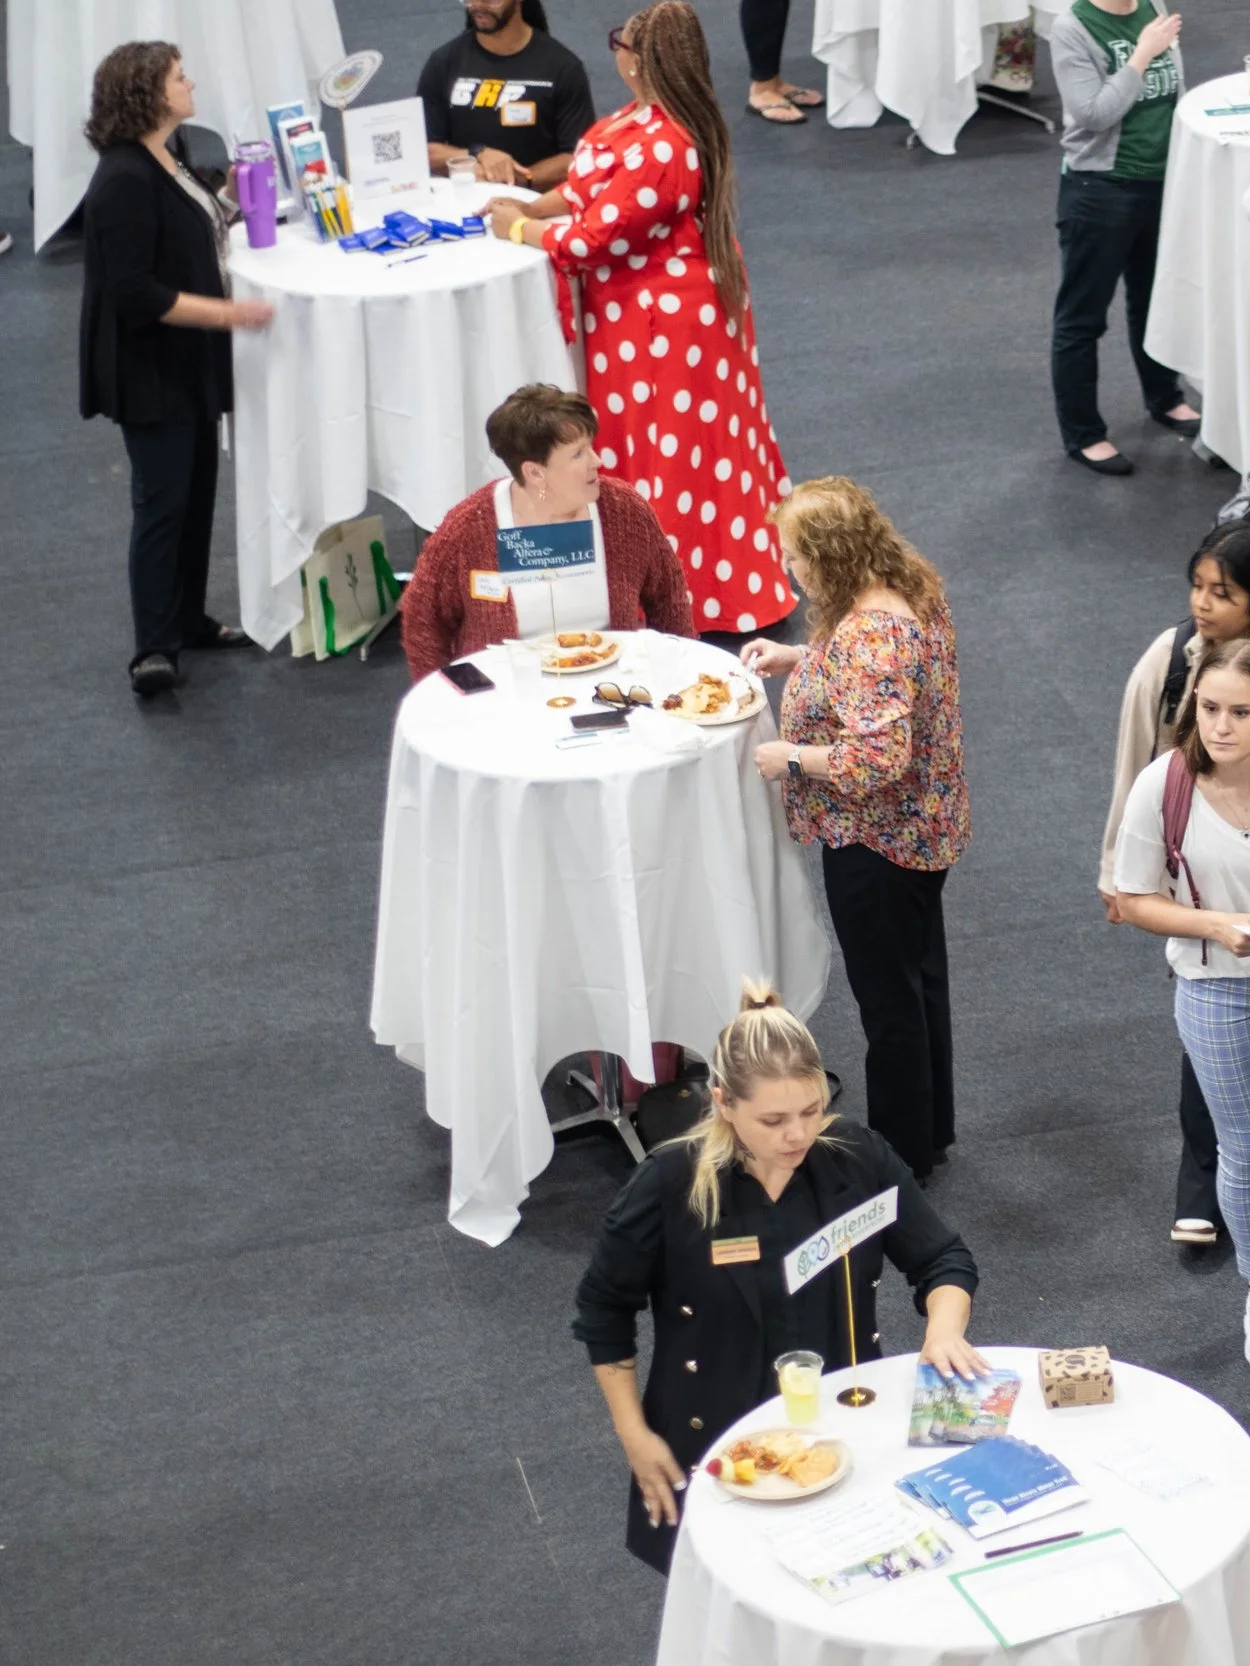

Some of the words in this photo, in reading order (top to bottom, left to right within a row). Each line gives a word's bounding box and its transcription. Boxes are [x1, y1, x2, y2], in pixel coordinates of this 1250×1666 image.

[497, 529, 522, 542] Goff
[506, 539, 535, 550] Backa
[519, 554, 569, 567] Company,
[571, 549, 594, 561] LLC
[830, 1200, 886, 1246] friends
